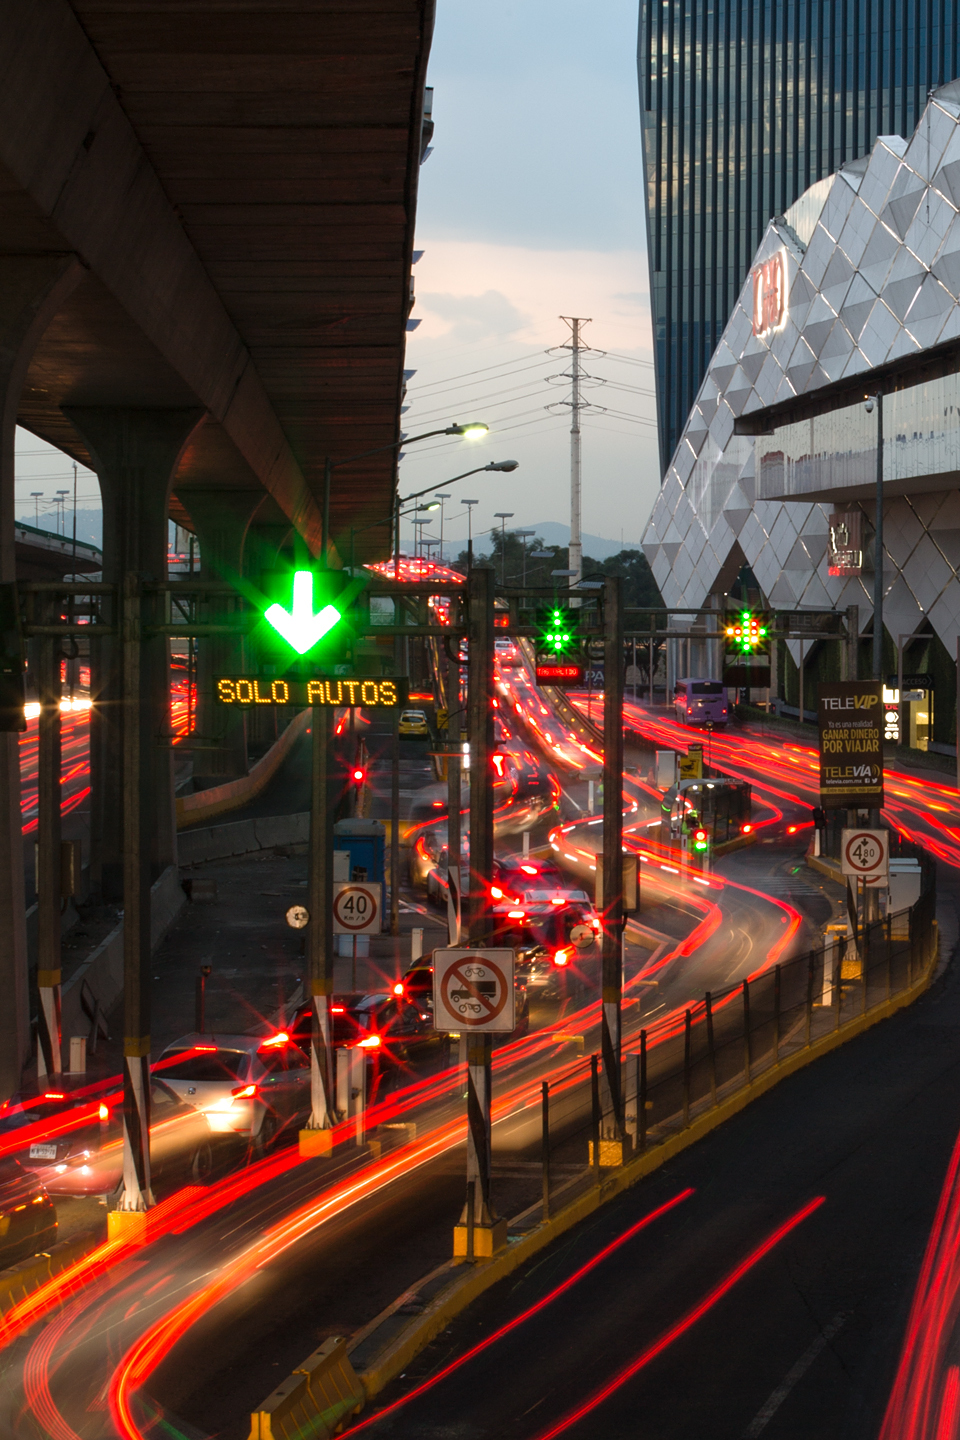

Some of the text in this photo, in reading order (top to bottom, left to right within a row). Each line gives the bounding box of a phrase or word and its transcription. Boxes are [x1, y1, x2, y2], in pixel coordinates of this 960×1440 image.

[218, 679, 397, 706] SOLO AUTOS
[821, 695, 879, 710] TELEVIP
[822, 729, 850, 740] GANAR
[851, 728, 879, 739] DINERO
[823, 739, 880, 753] POR VIAJAR
[823, 763, 872, 778] TELEVÍA
[343, 895, 367, 914] 40
